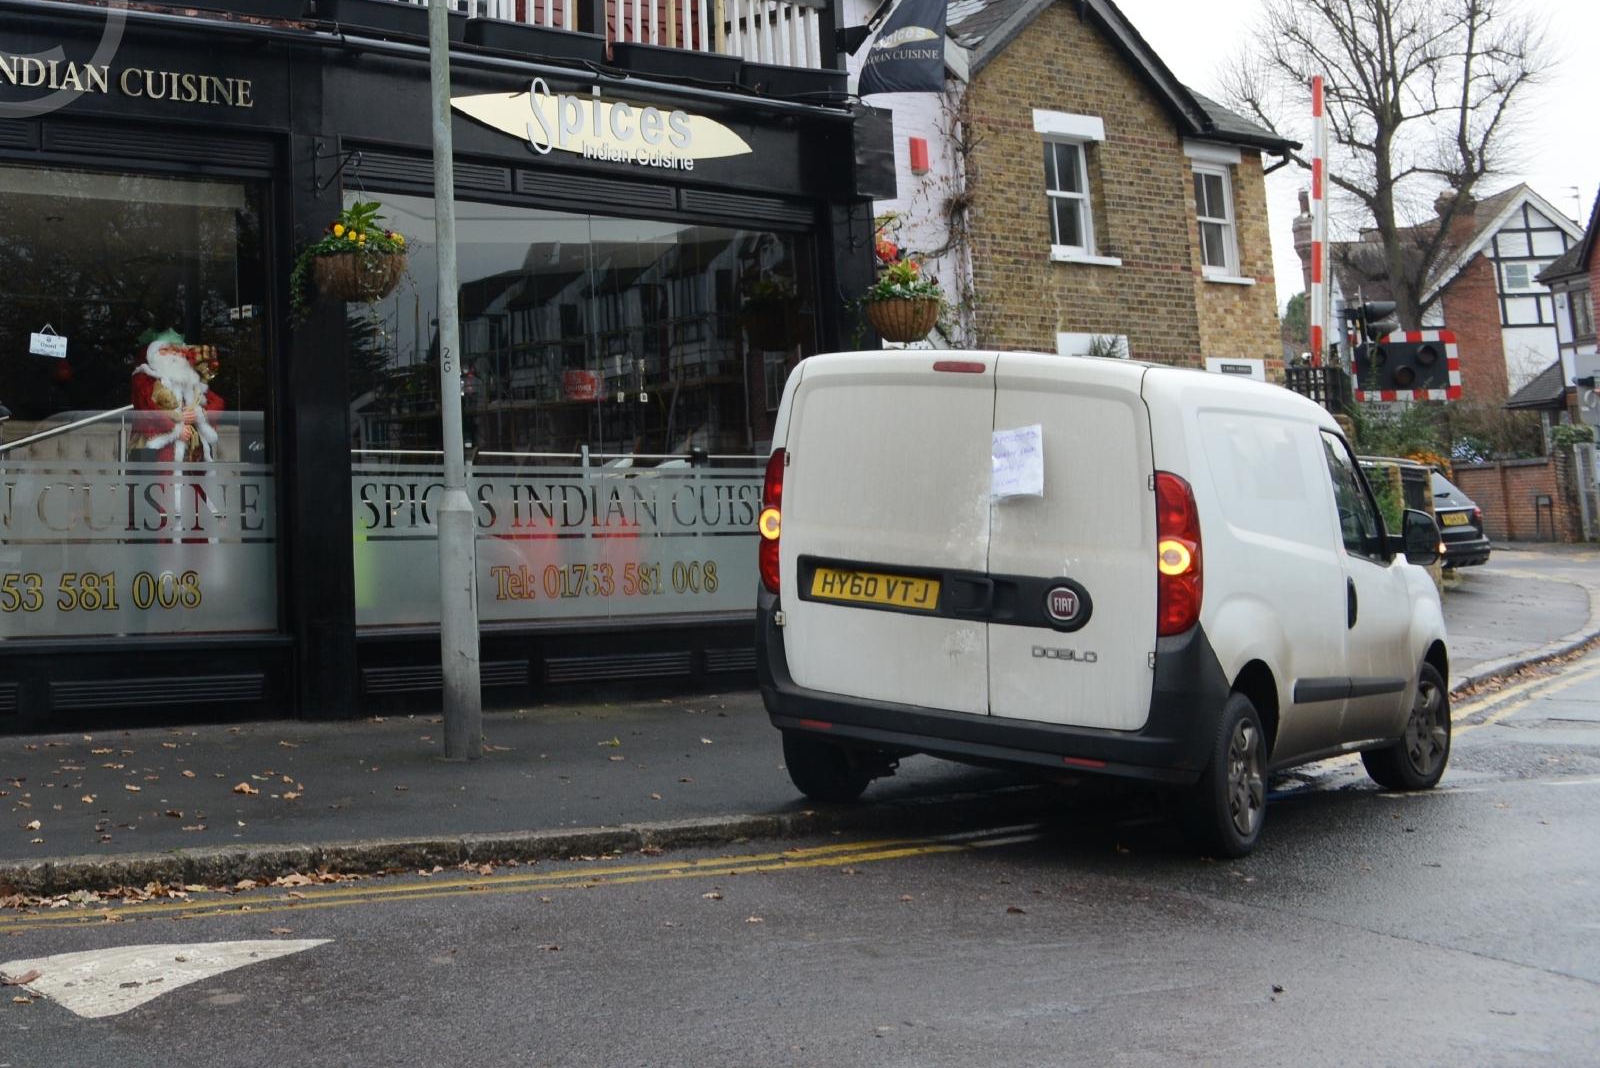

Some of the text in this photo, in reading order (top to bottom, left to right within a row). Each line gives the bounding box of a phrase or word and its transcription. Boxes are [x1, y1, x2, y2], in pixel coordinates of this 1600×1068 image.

[892, 49, 939, 61] CUISINE
[120, 67, 254, 108] CUISINE
[526, 77, 693, 155] Spices
[583, 140, 694, 171] Indian Cuisine
[37, 482, 264, 532] CUISINE
[360, 482, 498, 529] SPICS
[510, 484, 659, 528] INDIAN
[56, 571, 120, 612] 581
[131, 569, 203, 610] 008
[491, 559, 720, 601] Tel: 01753 581 008
[821, 572, 930, 605] HY60 VTJ
[1053, 596, 1073, 613] FIAT
